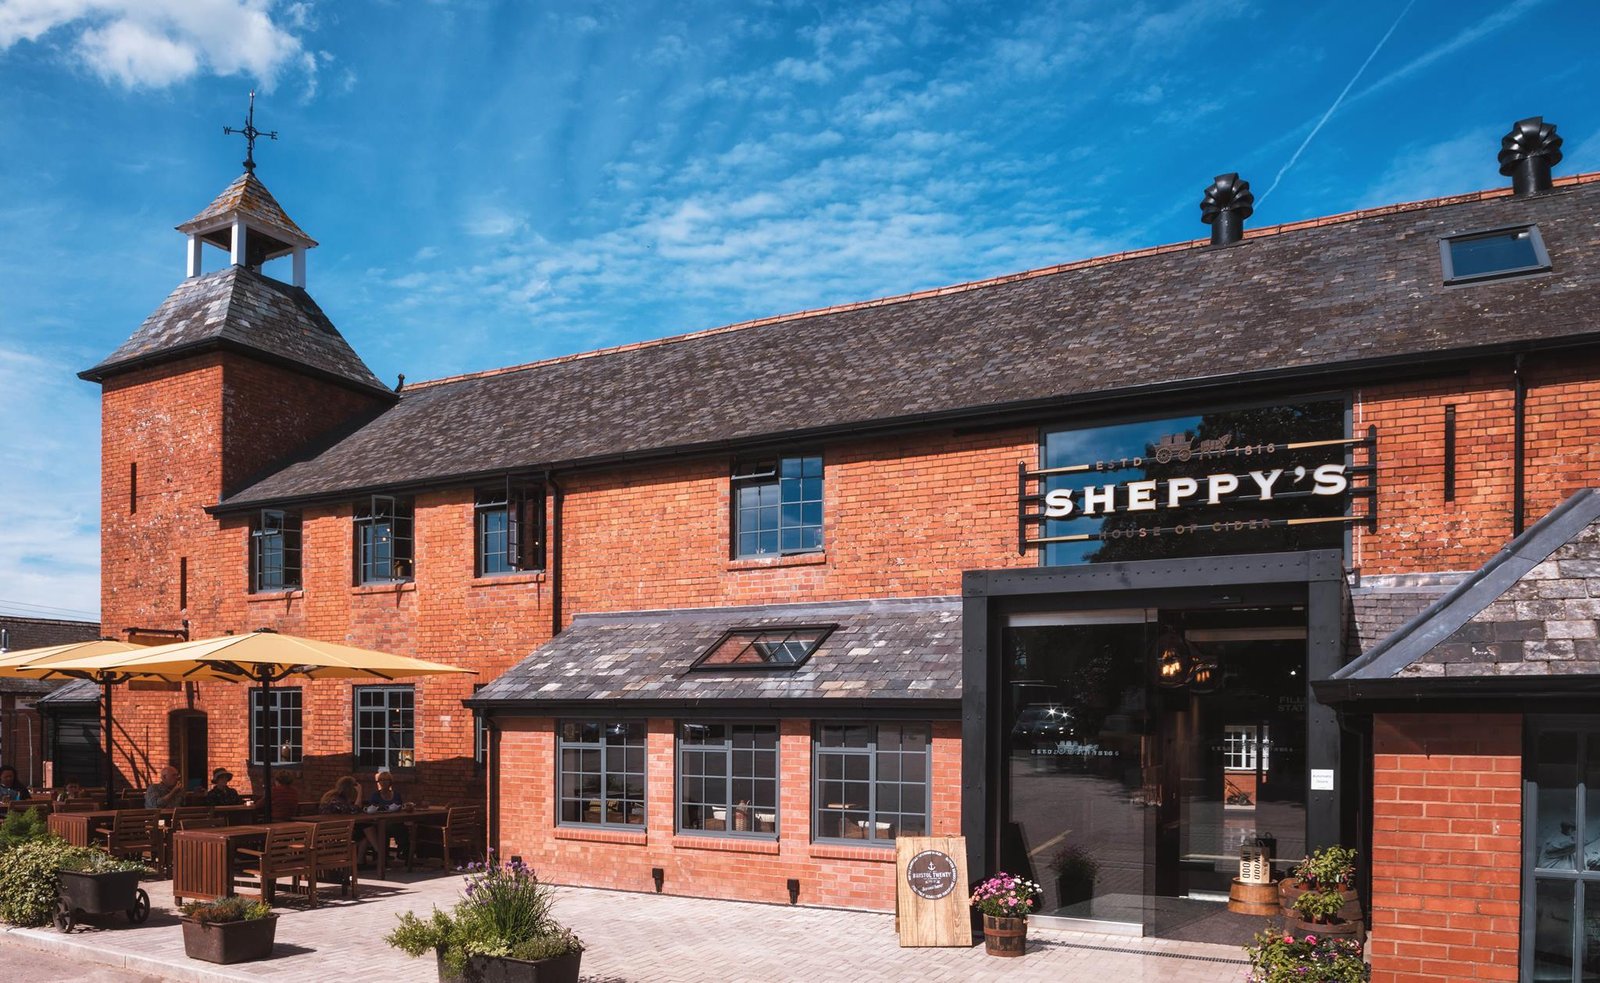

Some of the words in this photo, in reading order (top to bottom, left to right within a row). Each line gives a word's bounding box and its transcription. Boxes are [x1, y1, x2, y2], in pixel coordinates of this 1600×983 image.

[1096, 457, 1143, 471] ESTD
[1234, 443, 1275, 457] 1816
[1044, 464, 1348, 517] SHEPPY'S
[1099, 526, 1161, 540] HOUSE
[1175, 524, 1198, 536] OF
[1212, 519, 1271, 532] CIDER
